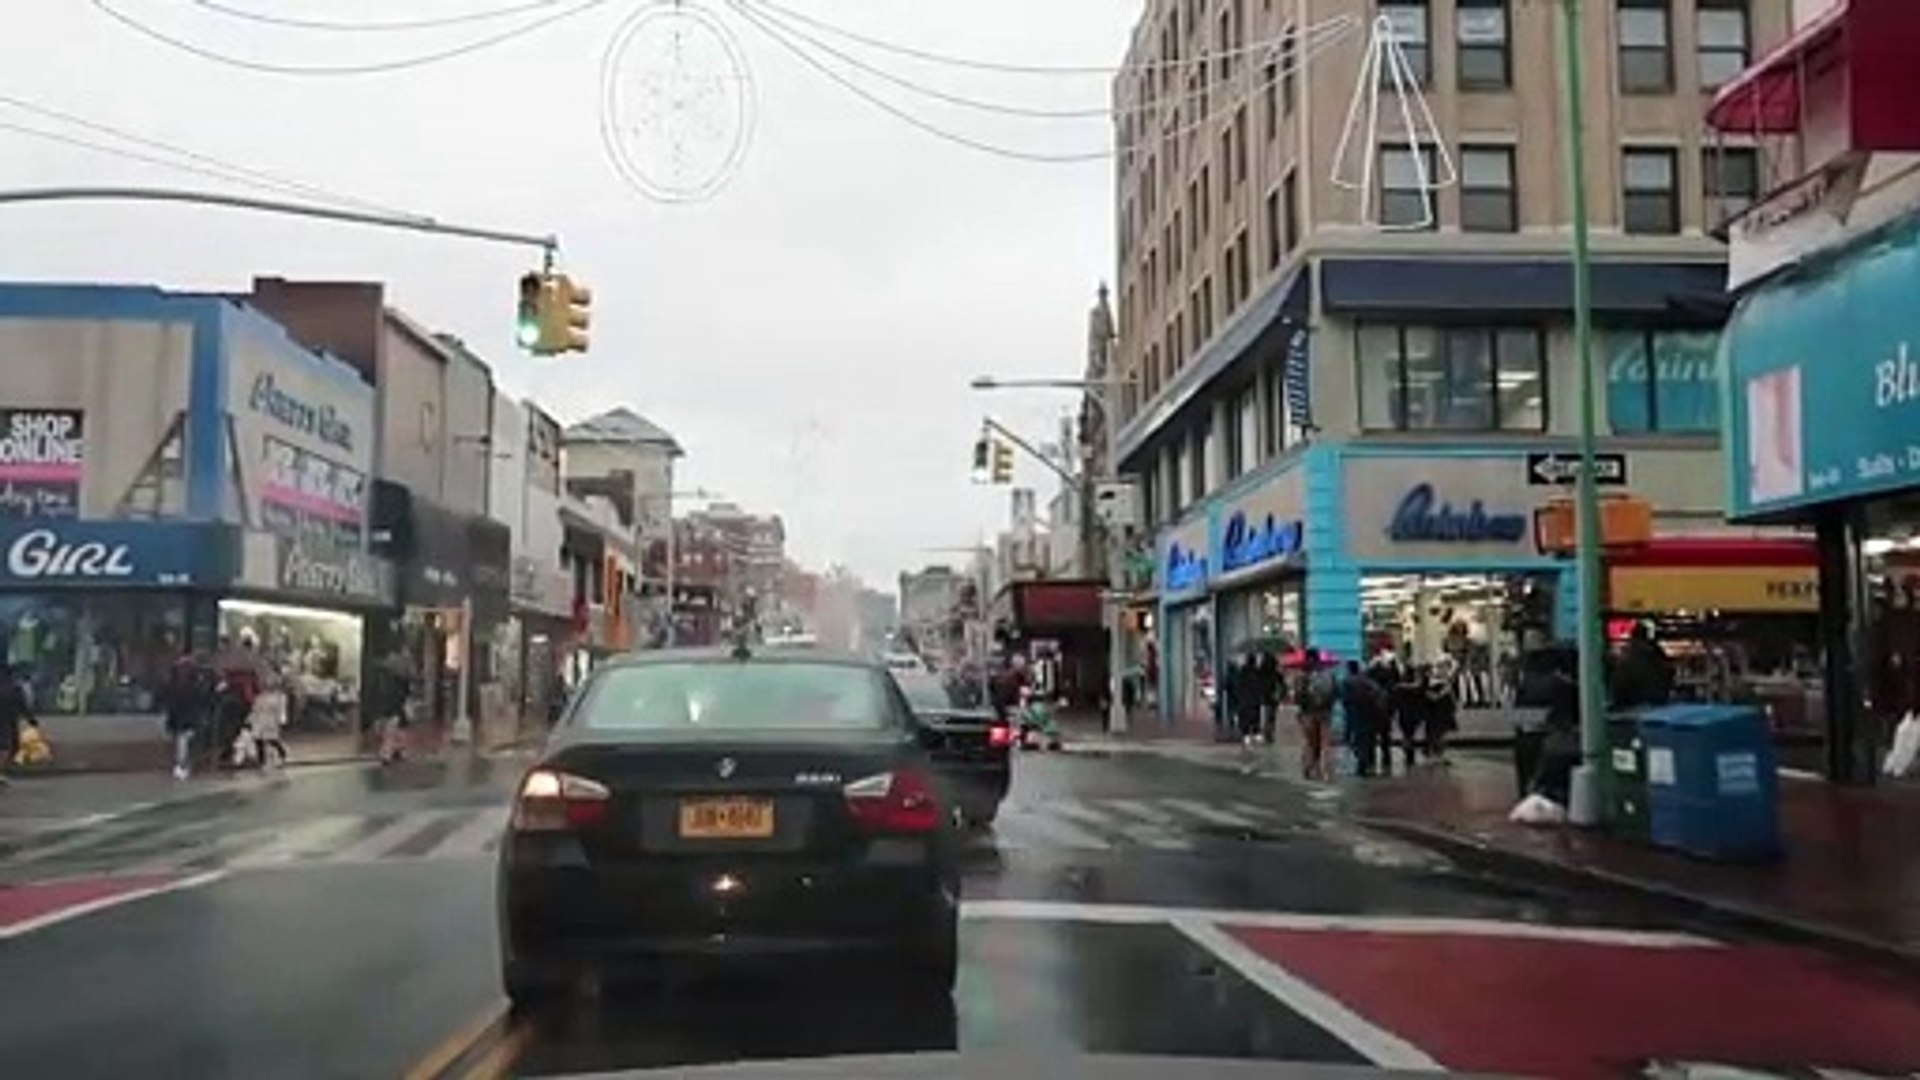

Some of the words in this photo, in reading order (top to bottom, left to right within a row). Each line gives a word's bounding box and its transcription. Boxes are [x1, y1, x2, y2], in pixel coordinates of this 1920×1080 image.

[11, 412, 74, 440] SHOP
[0, 438, 84, 463] ONLINE
[7, 529, 133, 577] GIRL
